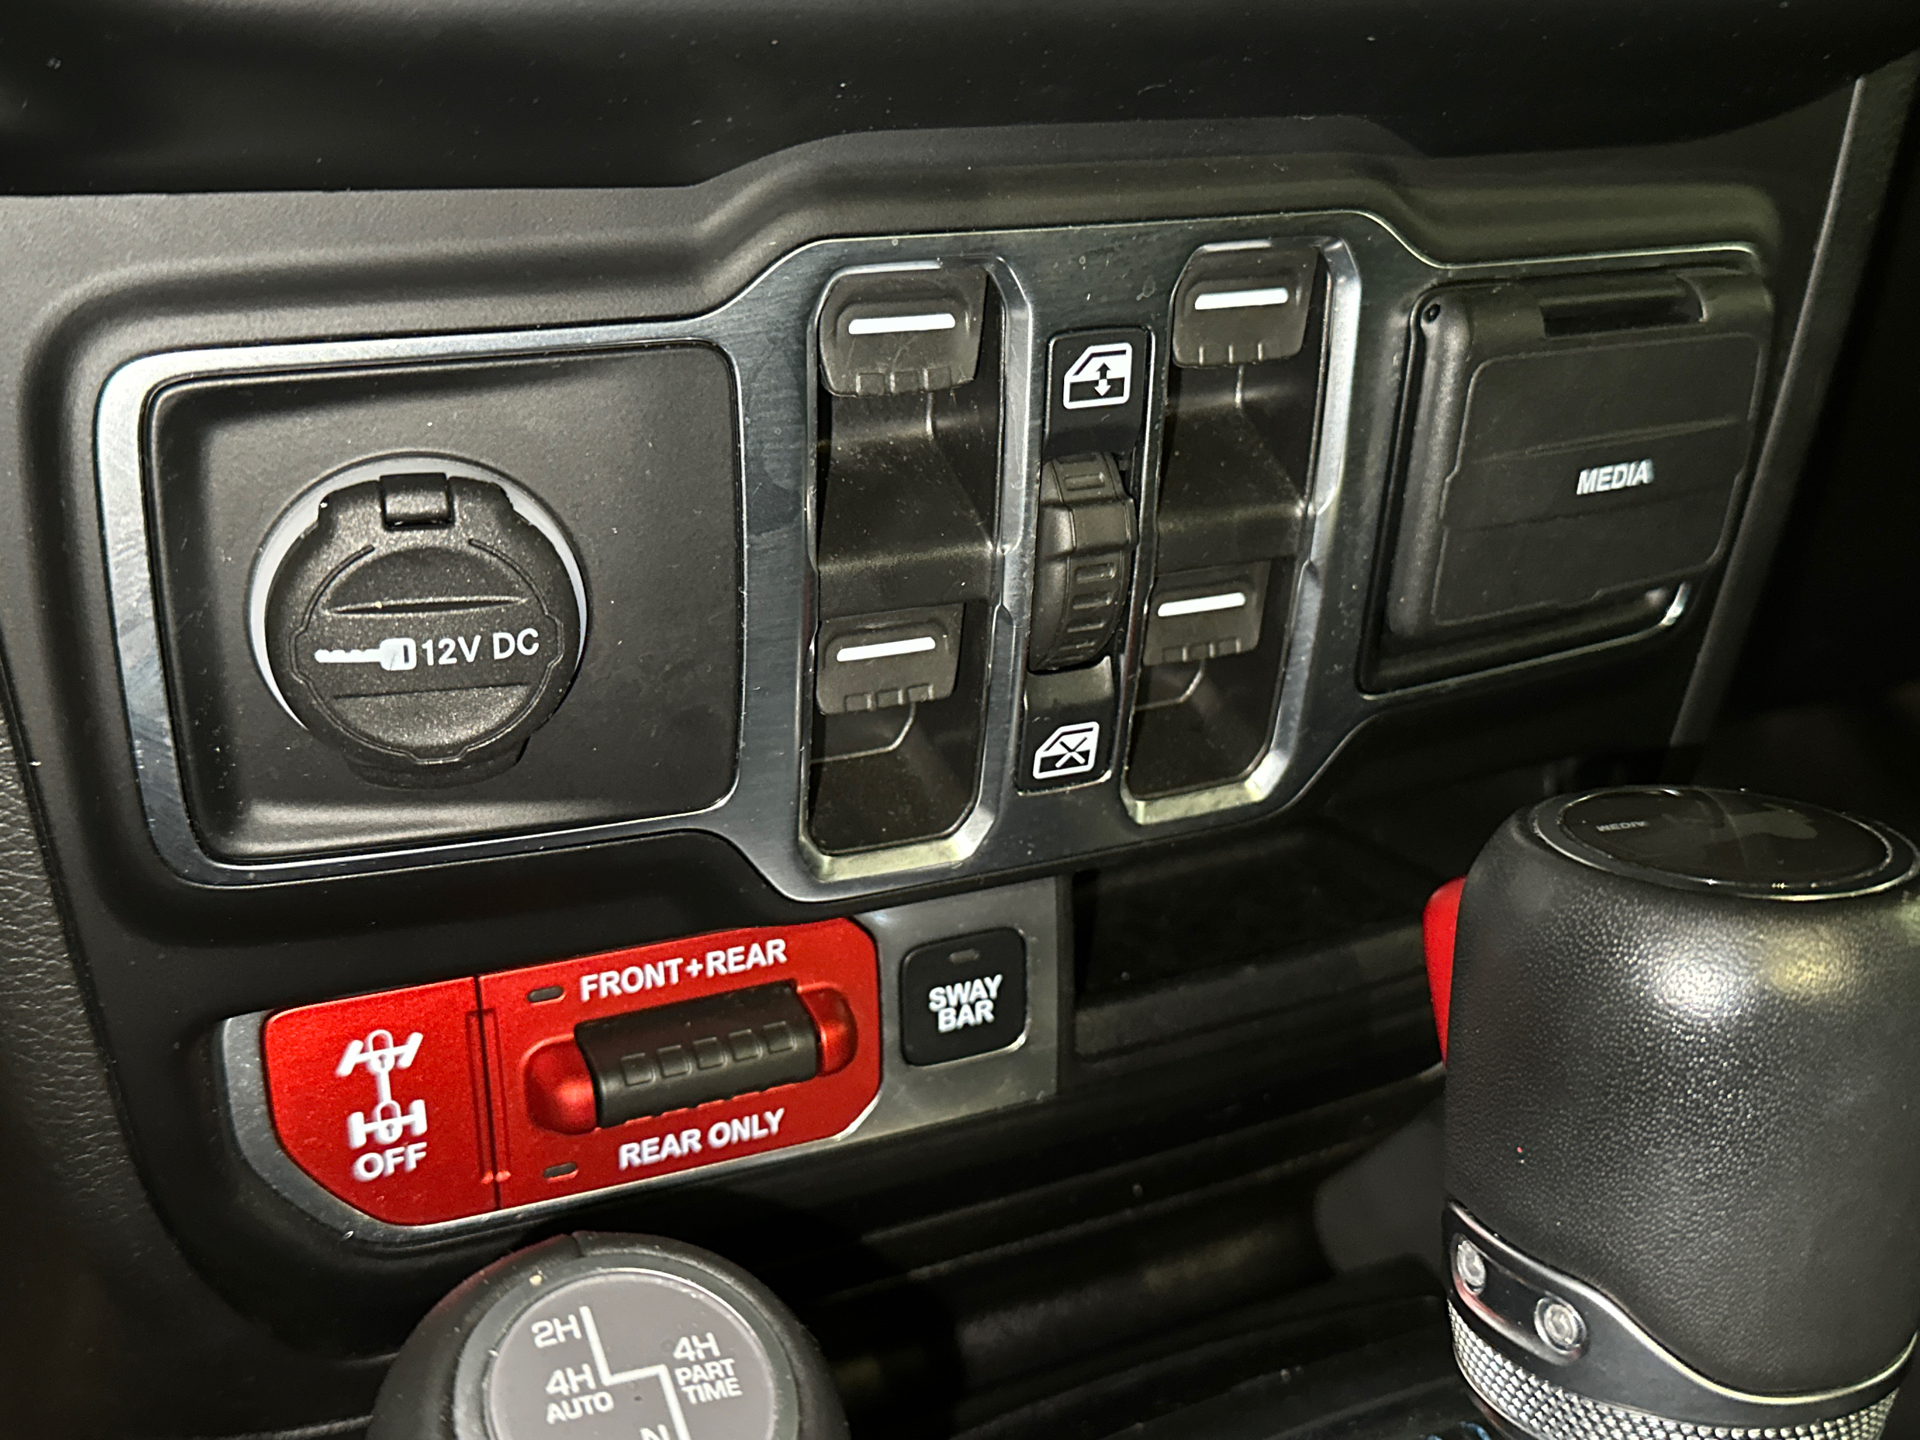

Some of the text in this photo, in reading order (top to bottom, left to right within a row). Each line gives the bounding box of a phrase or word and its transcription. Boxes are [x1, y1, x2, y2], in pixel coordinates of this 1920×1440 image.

[1576, 458, 1655, 495] MEDIA
[421, 627, 540, 666] 12V DC
[579, 937, 788, 1002] FRONT+REAR
[928, 974, 1003, 1012] SWAY
[938, 997, 995, 1034] BAR
[618, 1109, 785, 1170] REAR ONLY
[350, 1142, 429, 1182] OFF
[531, 1314, 582, 1348] 2H
[672, 1332, 721, 1362] 4H
[545, 1363, 597, 1396] 4H
[674, 1358, 736, 1386] PART
[546, 1391, 615, 1425] AUTO
[681, 1377, 743, 1405] TIME
